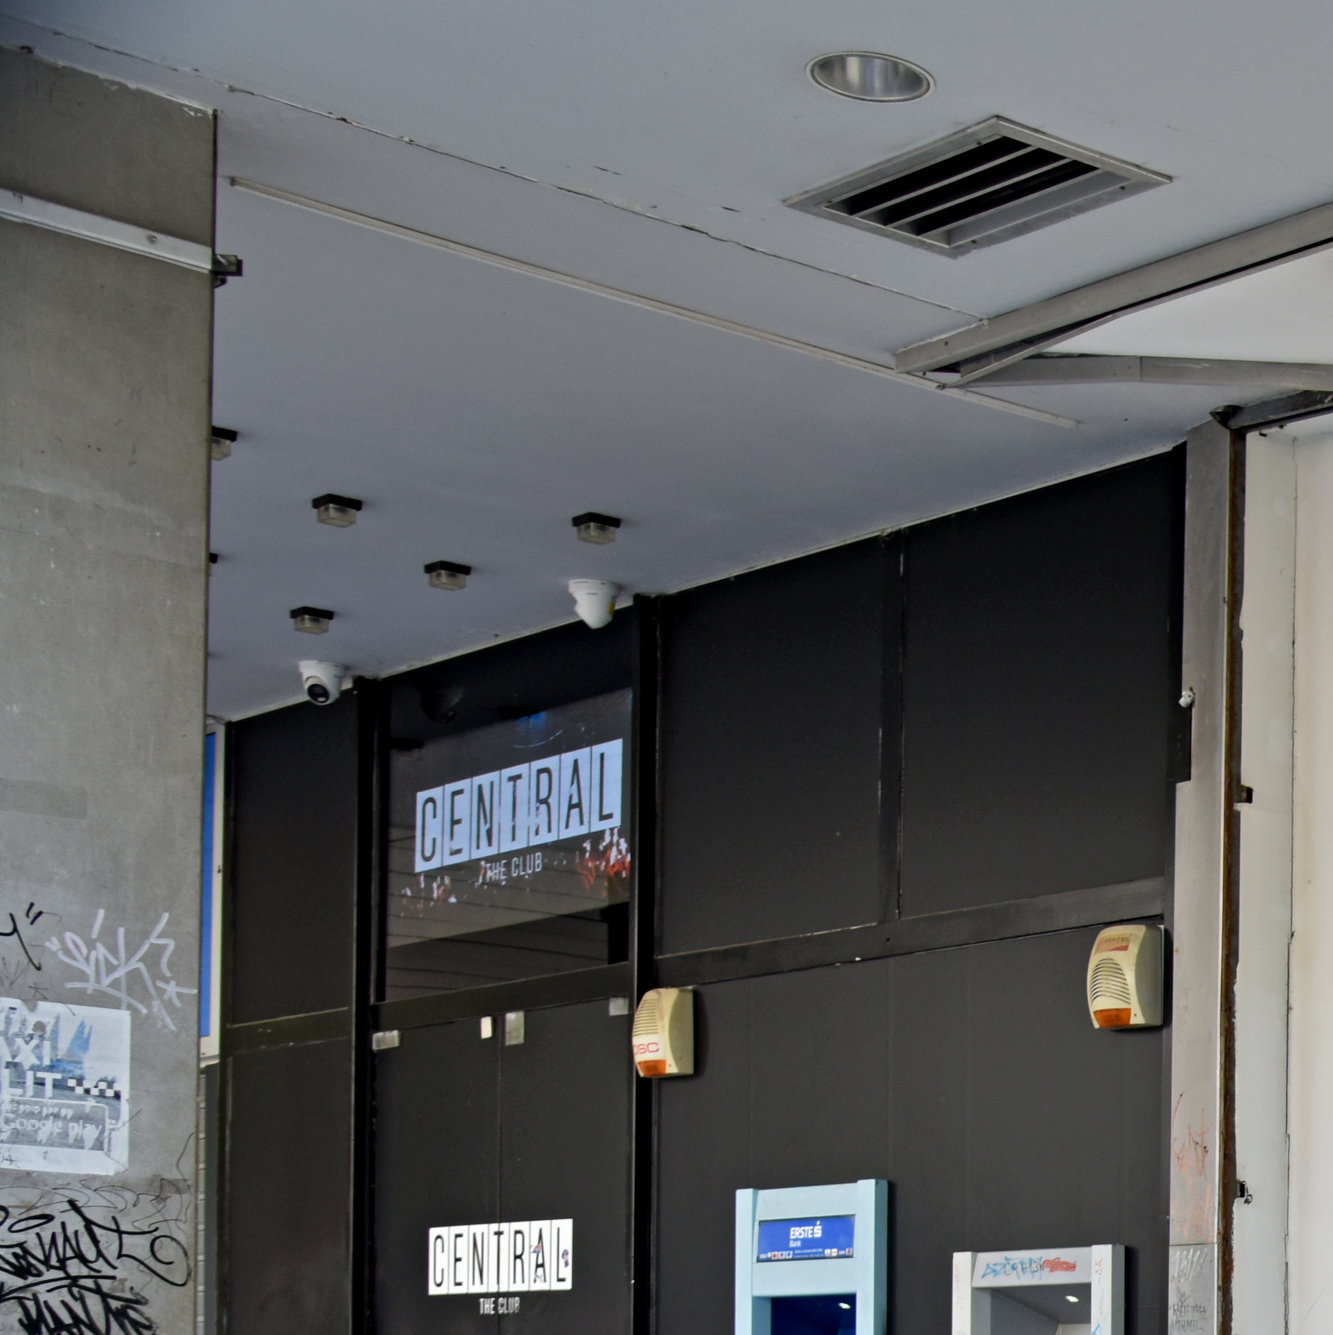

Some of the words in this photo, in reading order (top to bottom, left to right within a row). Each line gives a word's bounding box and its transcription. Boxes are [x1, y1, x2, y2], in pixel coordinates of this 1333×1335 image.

[419, 750, 615, 864] CENTRAL
[486, 859, 507, 882] THE
[511, 851, 542, 877] CLUB
[432, 1226, 567, 1288] CENTRAL
[479, 1297, 496, 1314] THE
[498, 1296, 520, 1314] CLUB
